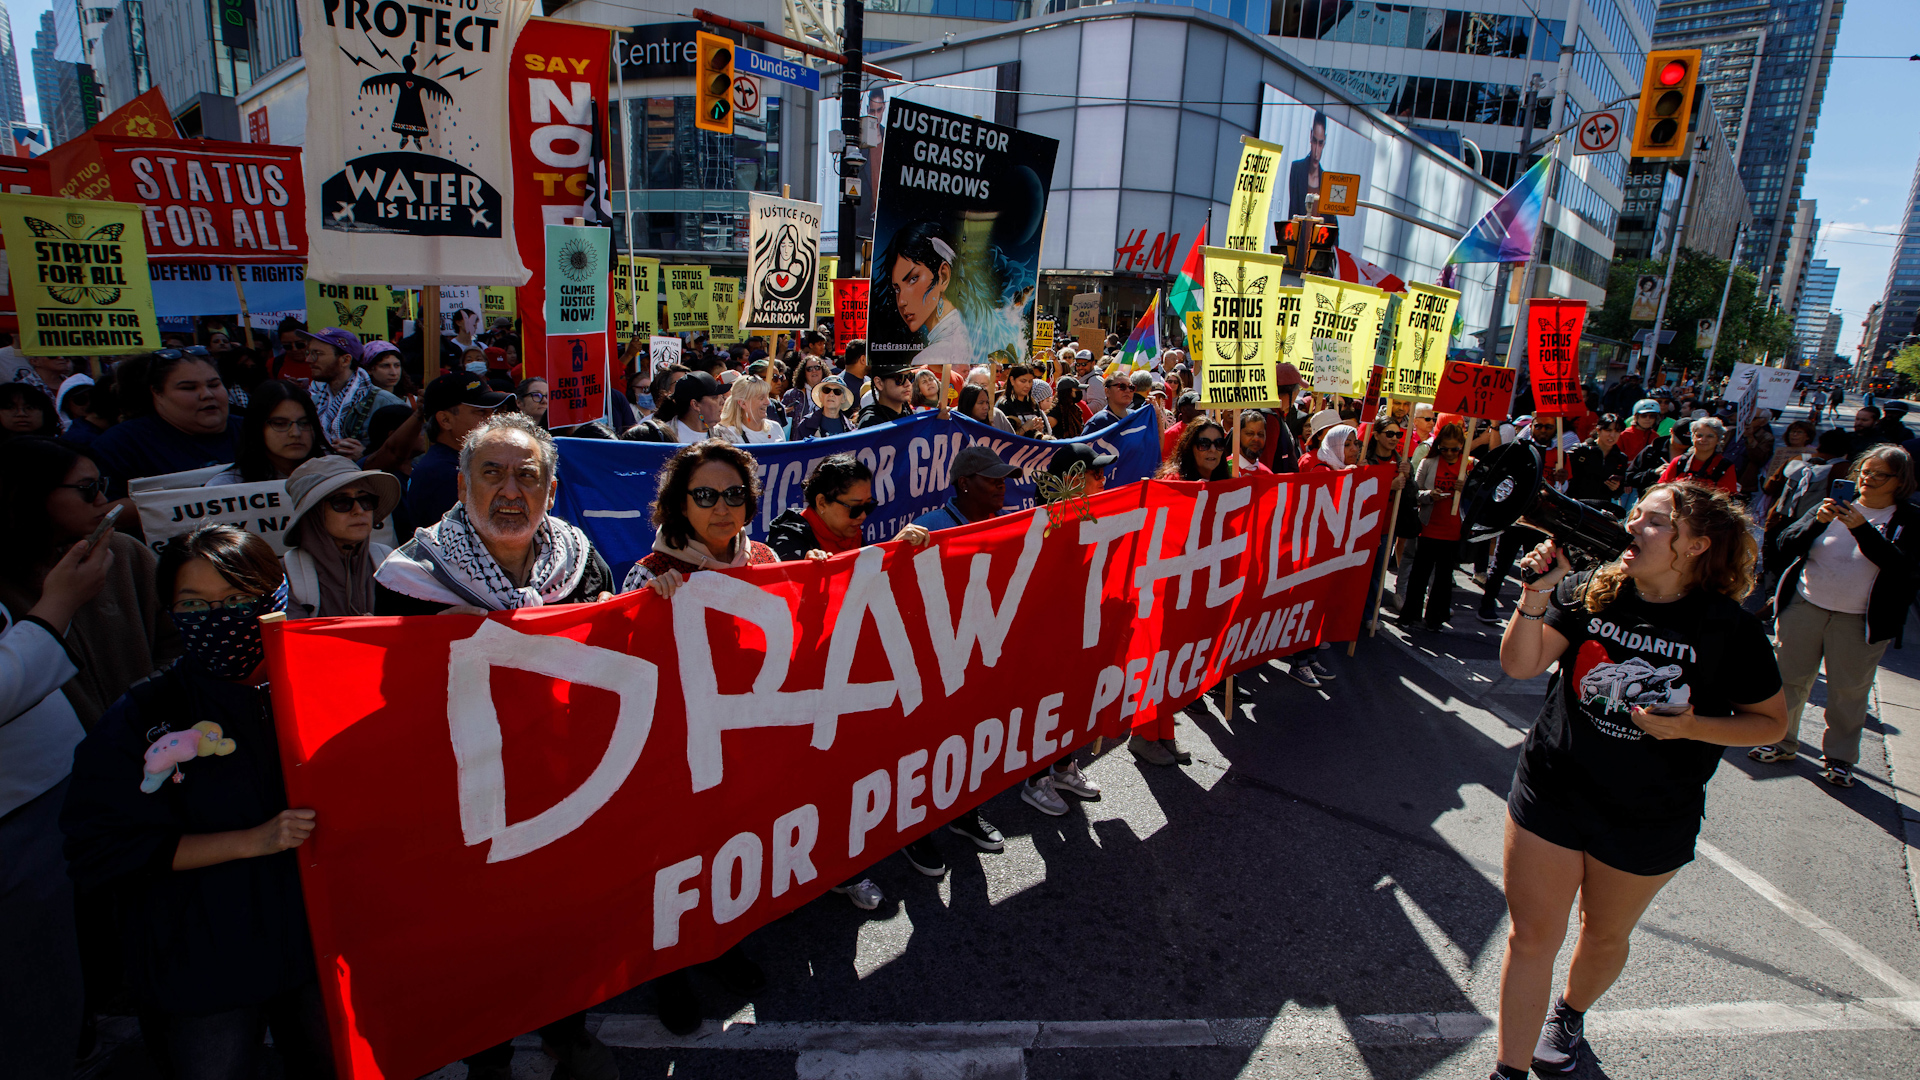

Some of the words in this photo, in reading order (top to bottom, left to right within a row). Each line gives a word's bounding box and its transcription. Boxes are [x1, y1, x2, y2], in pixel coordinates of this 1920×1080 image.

[613, 37, 697, 67] Centre
[524, 53, 591, 75] SAY
[751, 53, 797, 80] Dundas
[800, 67, 807, 77] St
[892, 107, 972, 145] JUSTICE
[976, 126, 1010, 153] FOR
[913, 140, 986, 173] GRASSY
[1243, 153, 1272, 174] STATUS
[130, 156, 290, 207] STATUS
[345, 164, 485, 207] WATER
[900, 165, 990, 200] NARROWS
[1237, 173, 1254, 192] FOR
[1254, 175, 1268, 193] ALL
[1329, 175, 1353, 183] PRIORITY
[1626, 173, 1662, 186] GERS
[1640, 188, 1660, 198] OF
[378, 201, 399, 218] IS
[406, 203, 452, 221] LIFE
[1324, 203, 1350, 212] CROSSING
[760, 206, 797, 220] JUSTICE
[800, 211, 819, 228] FOR
[143, 205, 220, 248] FOR
[231, 209, 299, 251] ALL
[1228, 236, 1245, 249] STOP
[35, 241, 123, 264] STATUS
[1115, 228, 1181, 275] H&M
[38, 264, 84, 284] FOR
[90, 266, 127, 285] ALL
[151, 264, 212, 281] DEFEND
[252, 266, 304, 282] RIGHTS
[672, 270, 702, 279] STATUS
[319, 284, 349, 299] FOR
[354, 285, 379, 301] ALL
[560, 285, 595, 295] CLIMATE
[672, 281, 687, 290] FOR
[690, 281, 704, 290] ALL
[713, 282, 733, 292] STATUS
[560, 296, 595, 307] JUSTICE
[712, 293, 724, 302] FOR
[725, 293, 733, 303] ALL
[763, 300, 800, 312] GRASSY
[842, 301, 867, 310] STATUS
[1415, 293, 1449, 315] STATUS
[560, 308, 595, 321] NOW!
[1213, 296, 1263, 318] STATUS
[36, 313, 103, 328] DIGNITY
[109, 313, 140, 328] FOR
[673, 312, 692, 320] STOP
[694, 312, 708, 320] THE
[754, 313, 805, 324] NARROWS
[842, 311, 855, 320] FOR
[1313, 310, 1359, 332] STATUS
[1408, 311, 1429, 330] FOR
[1430, 315, 1445, 332] ALL
[711, 325, 724, 333] STOP
[725, 325, 733, 333] THE
[1211, 320, 1239, 339] FOR
[1243, 321, 1263, 339] ALL
[38, 330, 144, 346] MIGRANTS
[1315, 339, 1337, 352] WAGE
[1539, 333, 1572, 347] STATUS
[871, 342, 924, 351] FreeGrassy.net
[1539, 348, 1559, 362] FOR
[558, 377, 580, 388] END
[581, 374, 596, 386] THE
[1209, 369, 1246, 383] DIGNITY
[1249, 369, 1266, 382] FOR
[1399, 368, 1422, 385] STOP
[1422, 371, 1437, 387] THE
[551, 388, 581, 400] FOSSIL
[584, 384, 602, 396] FUEL
[1209, 386, 1268, 403] MIGRANTS
[1399, 385, 1437, 396] DEPORTATIONS
[1474, 386, 1495, 399] for
[569, 398, 588, 409] ERA
[171, 492, 281, 523] JUSTICE
[447, 508, 1047, 865] DRAW
[1078, 485, 1252, 651] THE
[1263, 474, 1381, 599] LINE
[1595, 717, 1628, 732] TURTLE
[652, 804, 819, 952] FOR
[848, 691, 1073, 858] PEOPLE.
[1087, 637, 1212, 732] PEACE.
[1214, 600, 1315, 675] PLANET.
